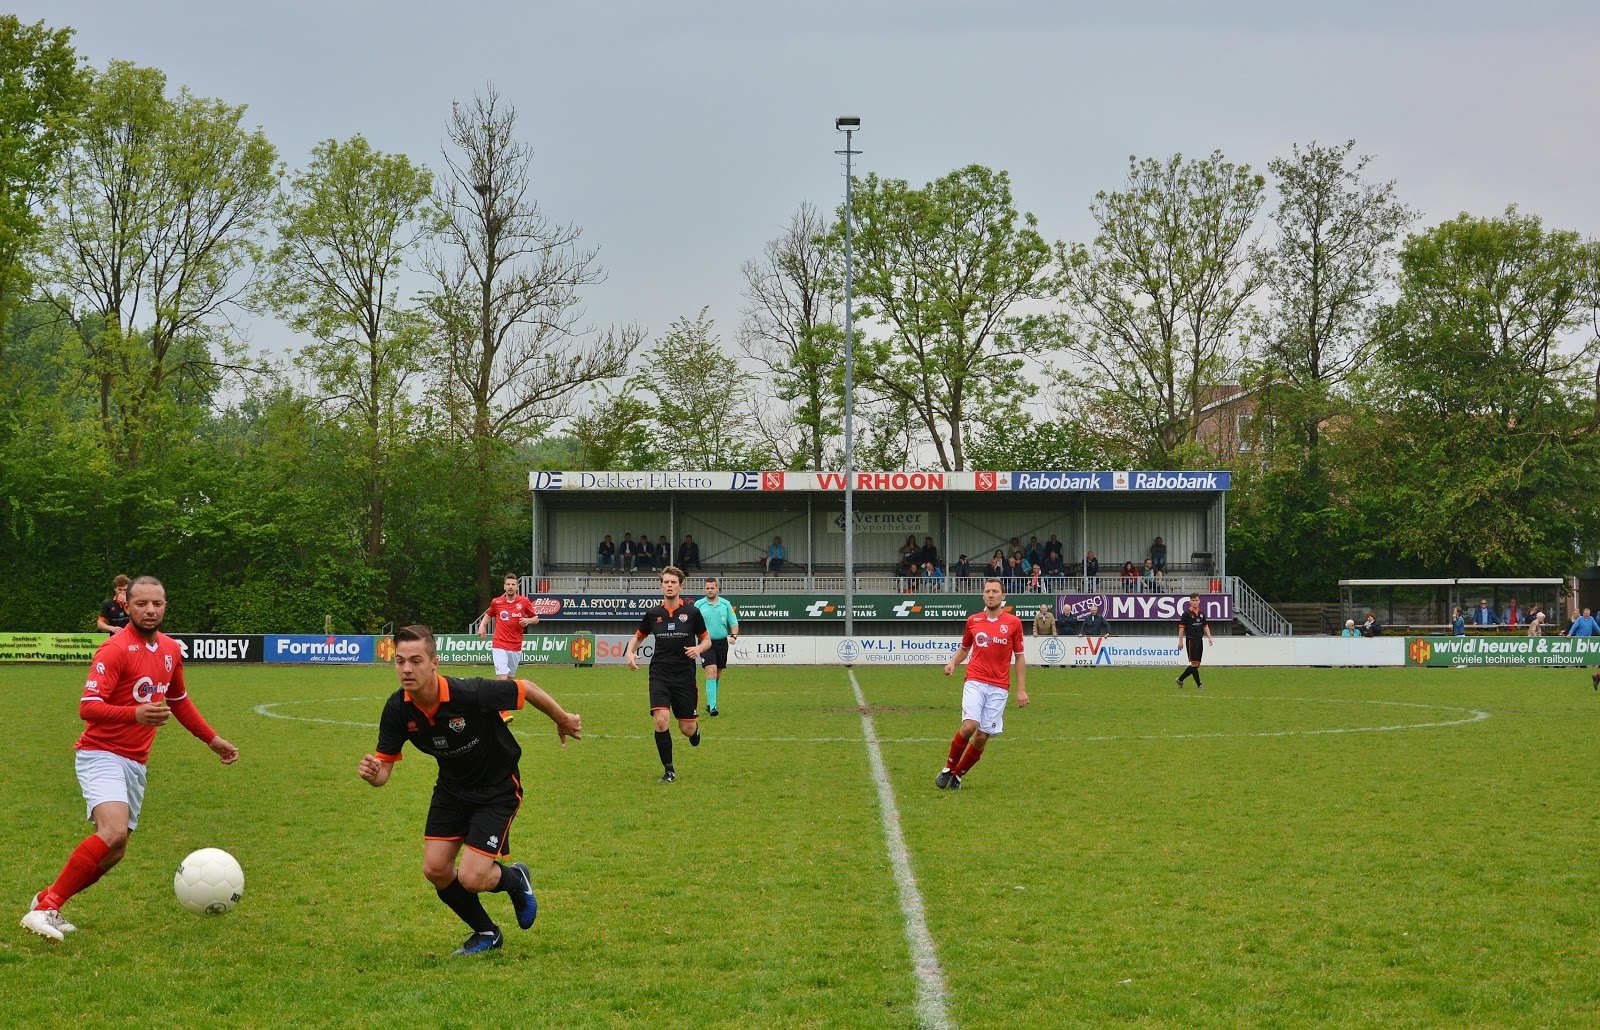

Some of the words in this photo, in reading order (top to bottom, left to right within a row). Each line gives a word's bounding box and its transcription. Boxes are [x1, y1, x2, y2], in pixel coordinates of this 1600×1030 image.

[580, 472, 643, 488] Dekker
[650, 473, 712, 488] Elektro
[816, 473, 847, 490] VV
[857, 473, 944, 490] RHOON
[1019, 473, 1101, 490] Rabobank
[1135, 472, 1217, 489] Rabobank
[855, 512, 922, 523] Vermeer
[855, 523, 921, 533] hypotheken
[535, 598, 557, 606] Bike
[563, 599, 578, 609] FA.
[580, 599, 590, 608] A.
[591, 599, 627, 608] STOUT
[628, 600, 637, 608] &
[1070, 595, 1102, 615] MYSC
[1112, 596, 1229, 618] MYSCnl
[193, 639, 250, 659] ROBEY
[277, 639, 360, 654] Formido
[446, 637, 493, 651] heuve
[757, 643, 785, 653] LBH
[861, 640, 896, 652] W.L.J.
[1479, 639, 1533, 653] heuvel
[1536, 638, 1548, 653] &
[452, 652, 492, 662] techniek
[521, 652, 550, 662] lbouw
[1452, 655, 1482, 663] civiele
[1485, 655, 1526, 663] techniek
[1543, 655, 1584, 663] railbouw
